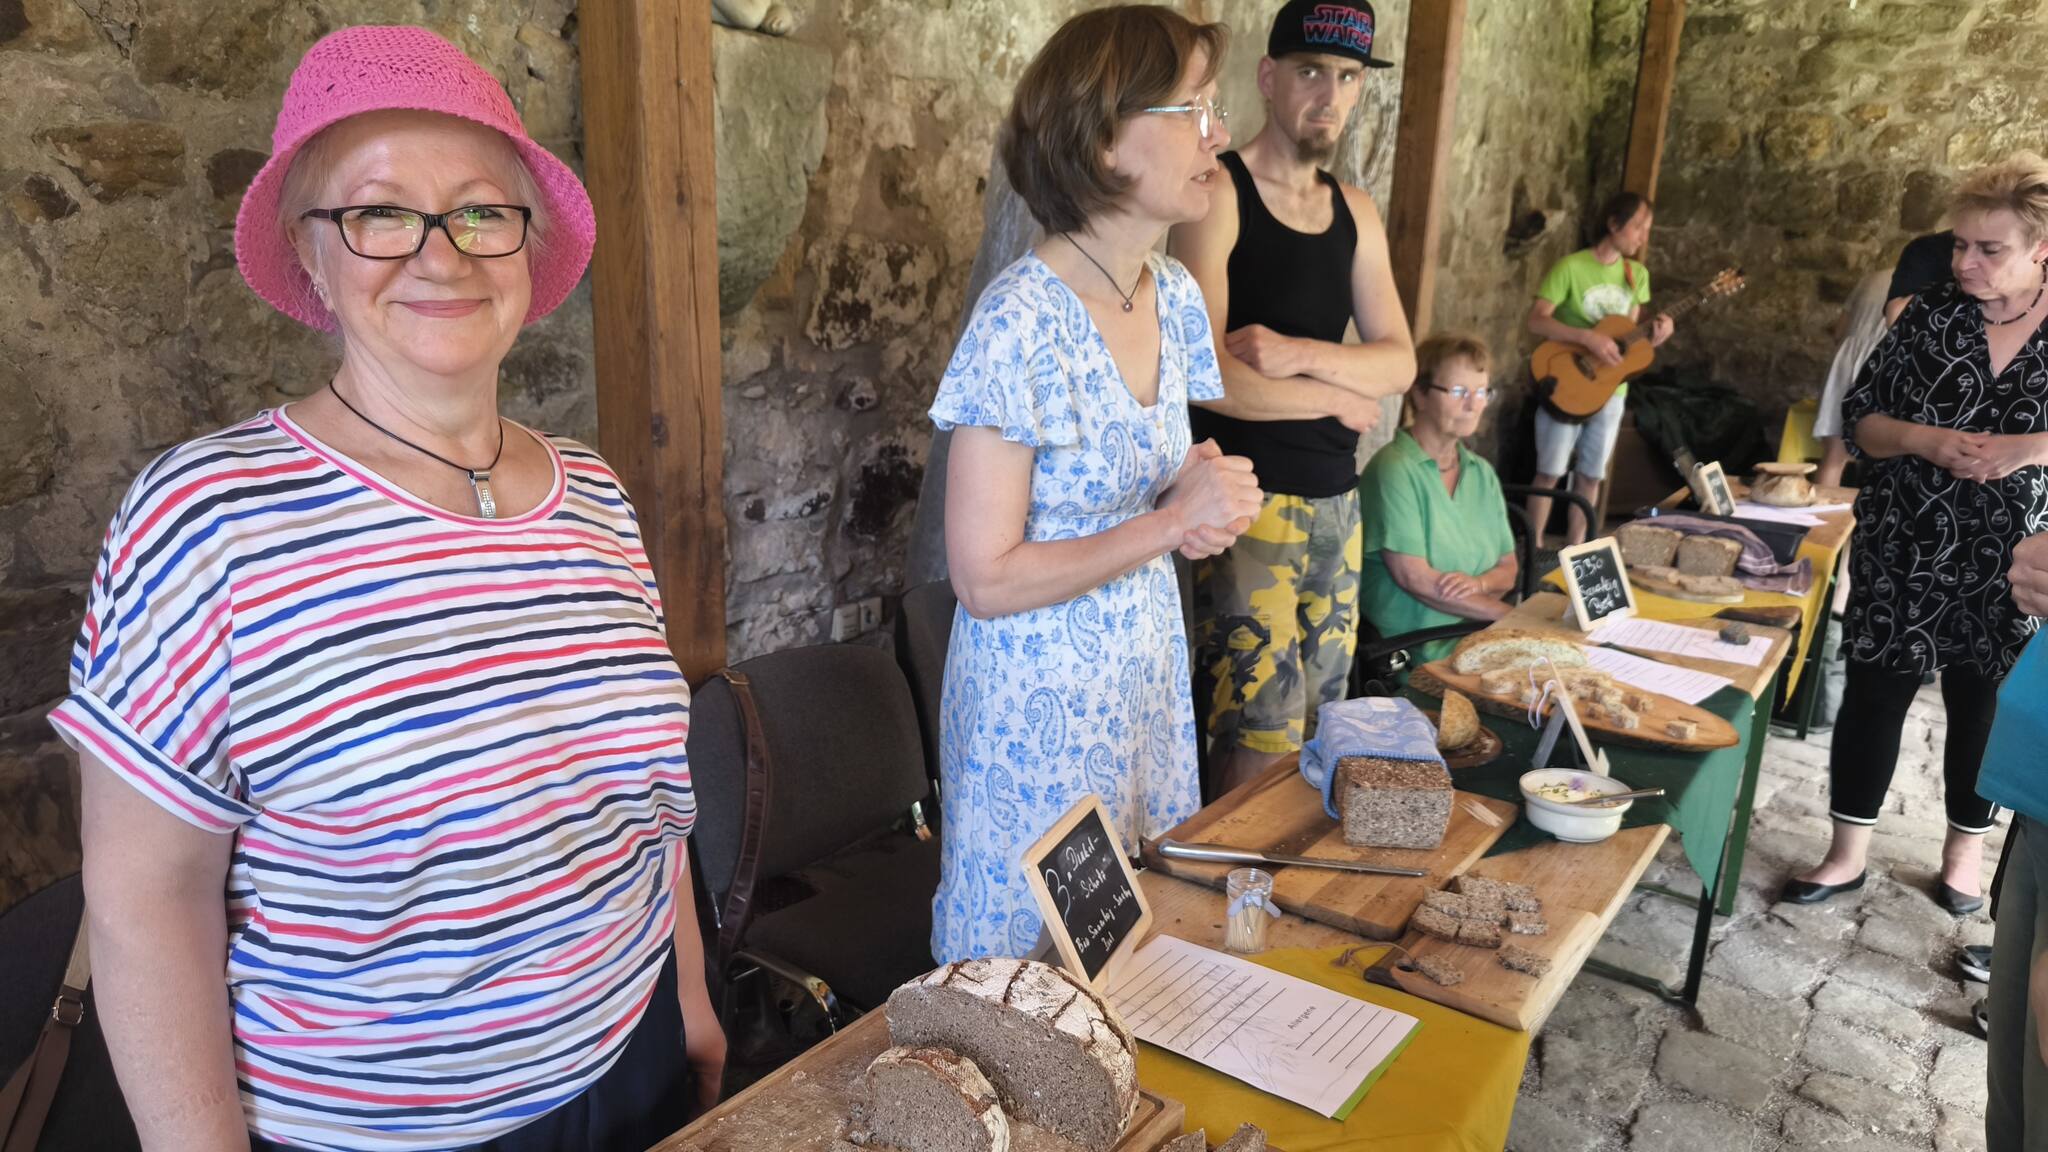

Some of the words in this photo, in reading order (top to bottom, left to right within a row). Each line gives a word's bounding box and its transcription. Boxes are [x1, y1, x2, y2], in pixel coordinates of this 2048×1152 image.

[1303, 4, 1373, 33] STAR
[1304, 23, 1372, 54] WARS
[1075, 937, 1090, 953] Bio
[1287, 1005, 1316, 1030] Allergene
